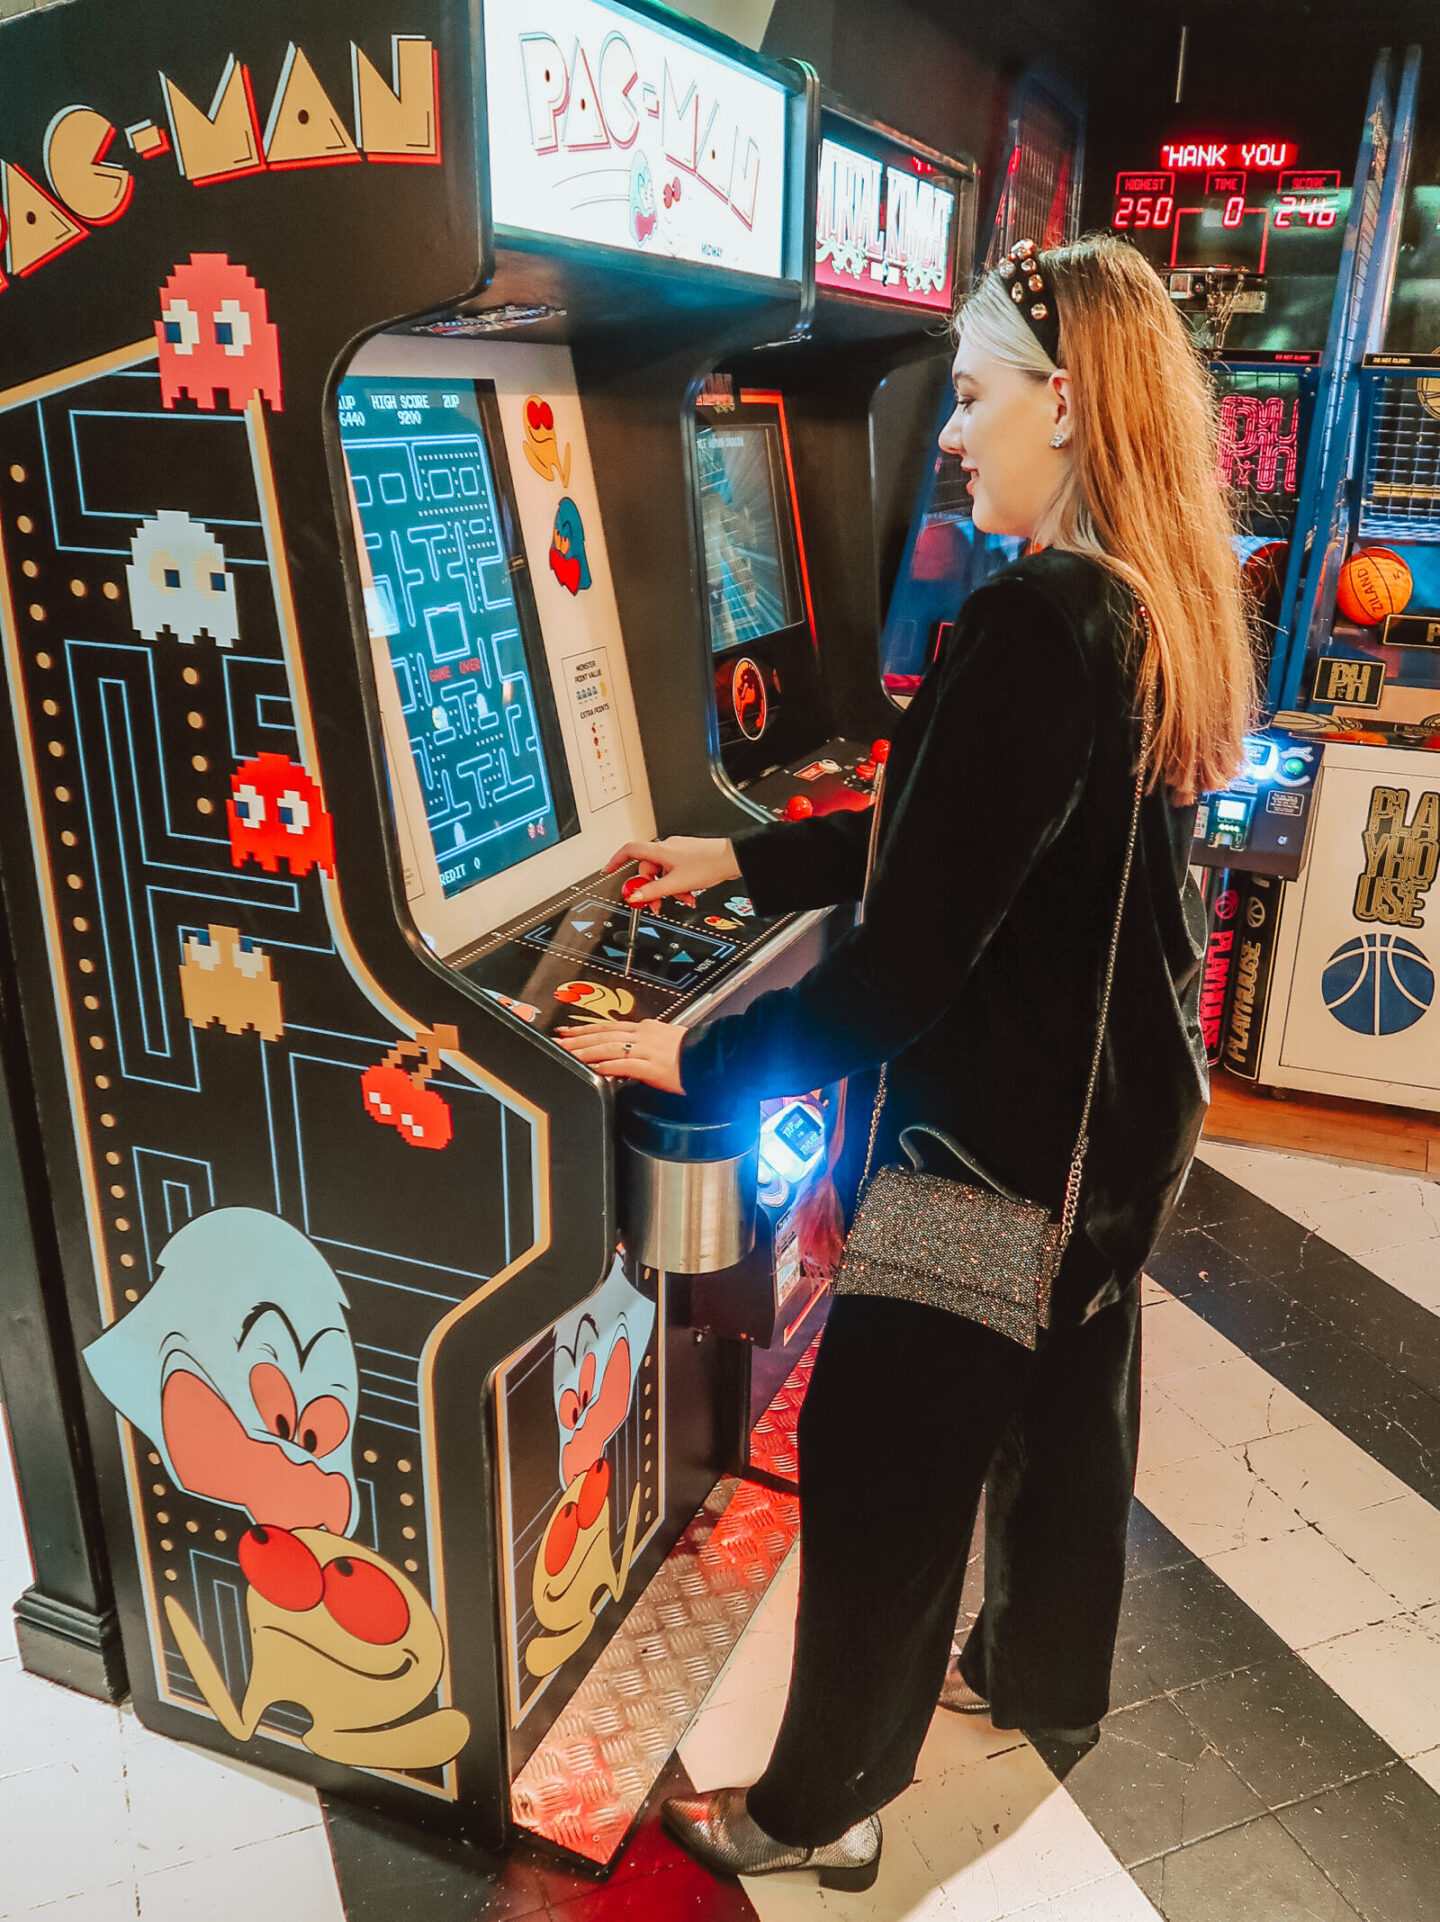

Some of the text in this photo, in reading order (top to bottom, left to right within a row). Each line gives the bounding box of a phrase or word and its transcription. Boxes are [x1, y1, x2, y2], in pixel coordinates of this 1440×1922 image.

[517, 29, 761, 232] PAC-MAN
[0, 34, 441, 292] AC-MAN
[1162, 144, 1287, 167] HANK YOU
[1124, 178, 1166, 191] HIGHEST
[1214, 178, 1238, 190] TIME
[1114, 196, 1174, 227] 250
[1222, 196, 1245, 227] 0
[371, 395, 397, 409] HIGH
[399, 394, 430, 409] SCORE
[442, 394, 460, 409] 2UP
[1327, 662, 1372, 702] PH
[439, 856, 481, 887] REDIT 0
